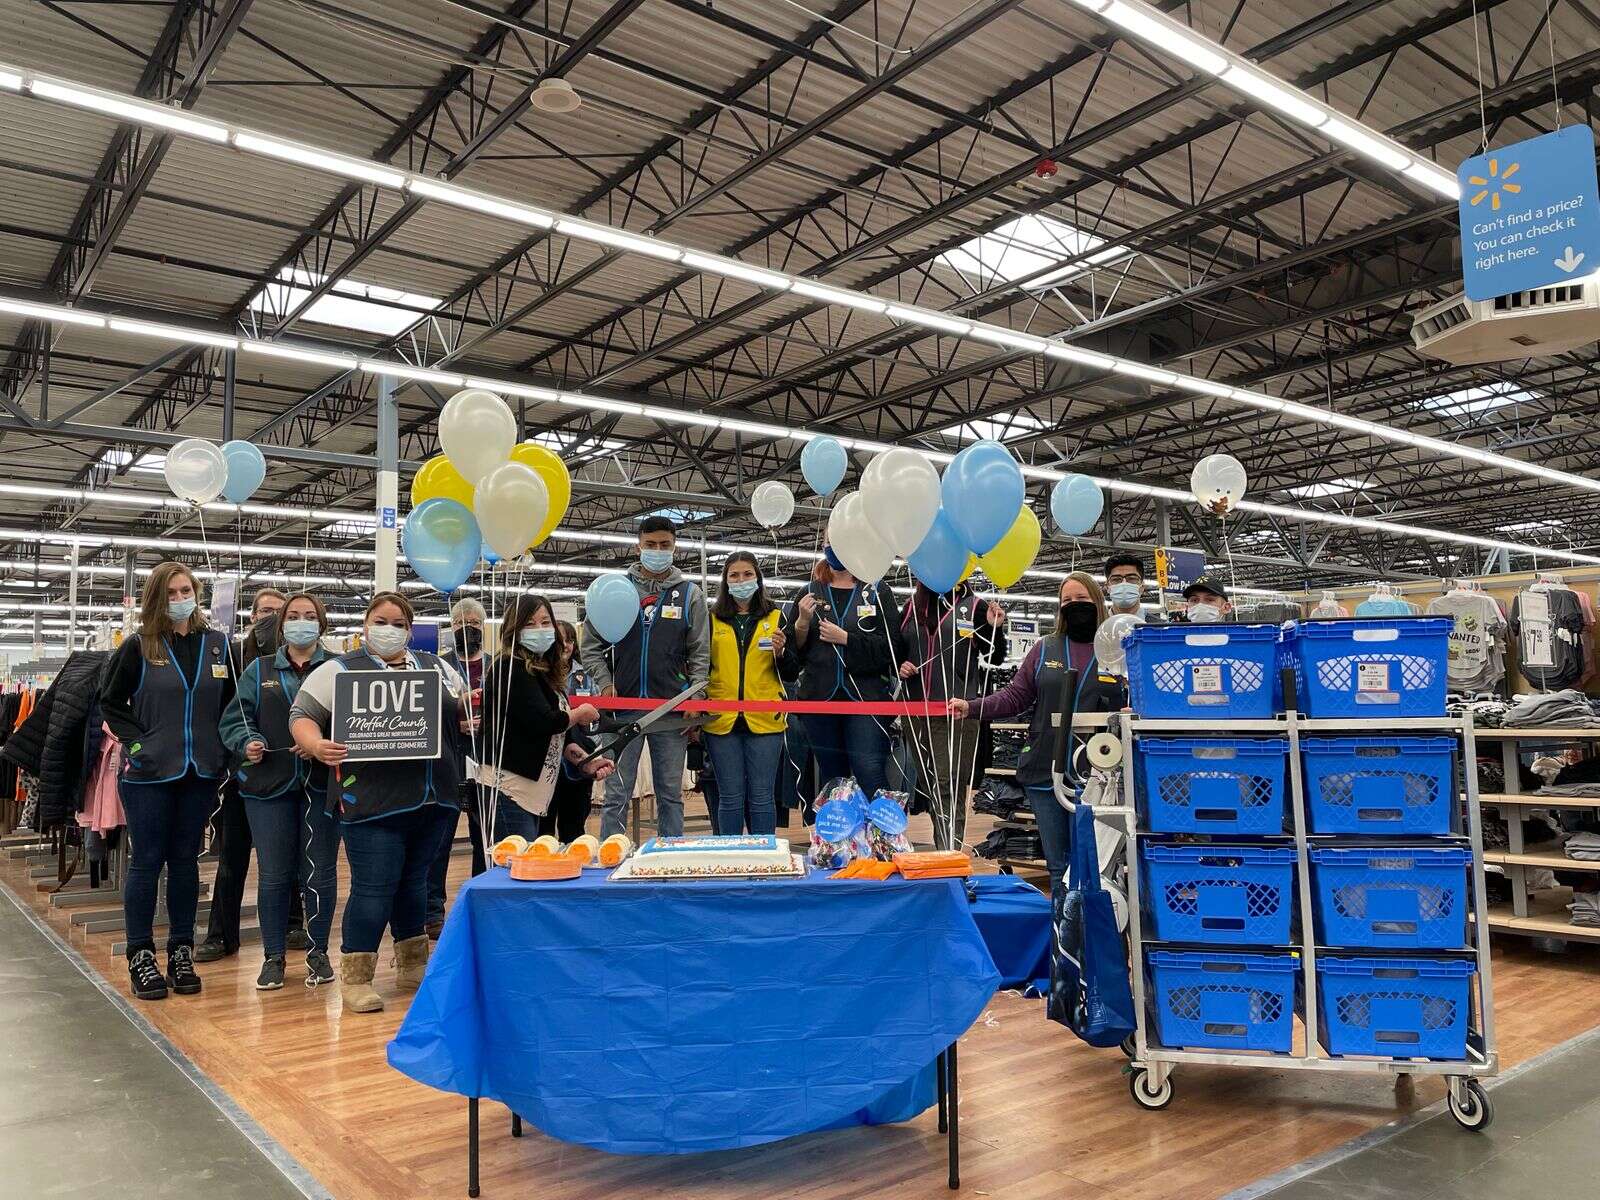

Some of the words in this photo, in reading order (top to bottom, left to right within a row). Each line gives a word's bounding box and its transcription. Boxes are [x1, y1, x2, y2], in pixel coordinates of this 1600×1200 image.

[1472, 218, 1505, 235] Can't
[1507, 209, 1532, 226] find
[1535, 210, 1543, 218] a
[1547, 195, 1584, 218] price?
[1473, 239, 1497, 252] You
[1500, 232, 1523, 245] can
[1526, 219, 1564, 239] check
[1567, 216, 1576, 228] it
[1475, 252, 1505, 270] right
[1507, 245, 1539, 260] here.
[352, 680, 425, 713] LOVE
[345, 715, 388, 731] Moffat
[389, 715, 429, 736] County
[362, 742, 389, 750] CHAMBER
[397, 741, 428, 749] COMMERCE
